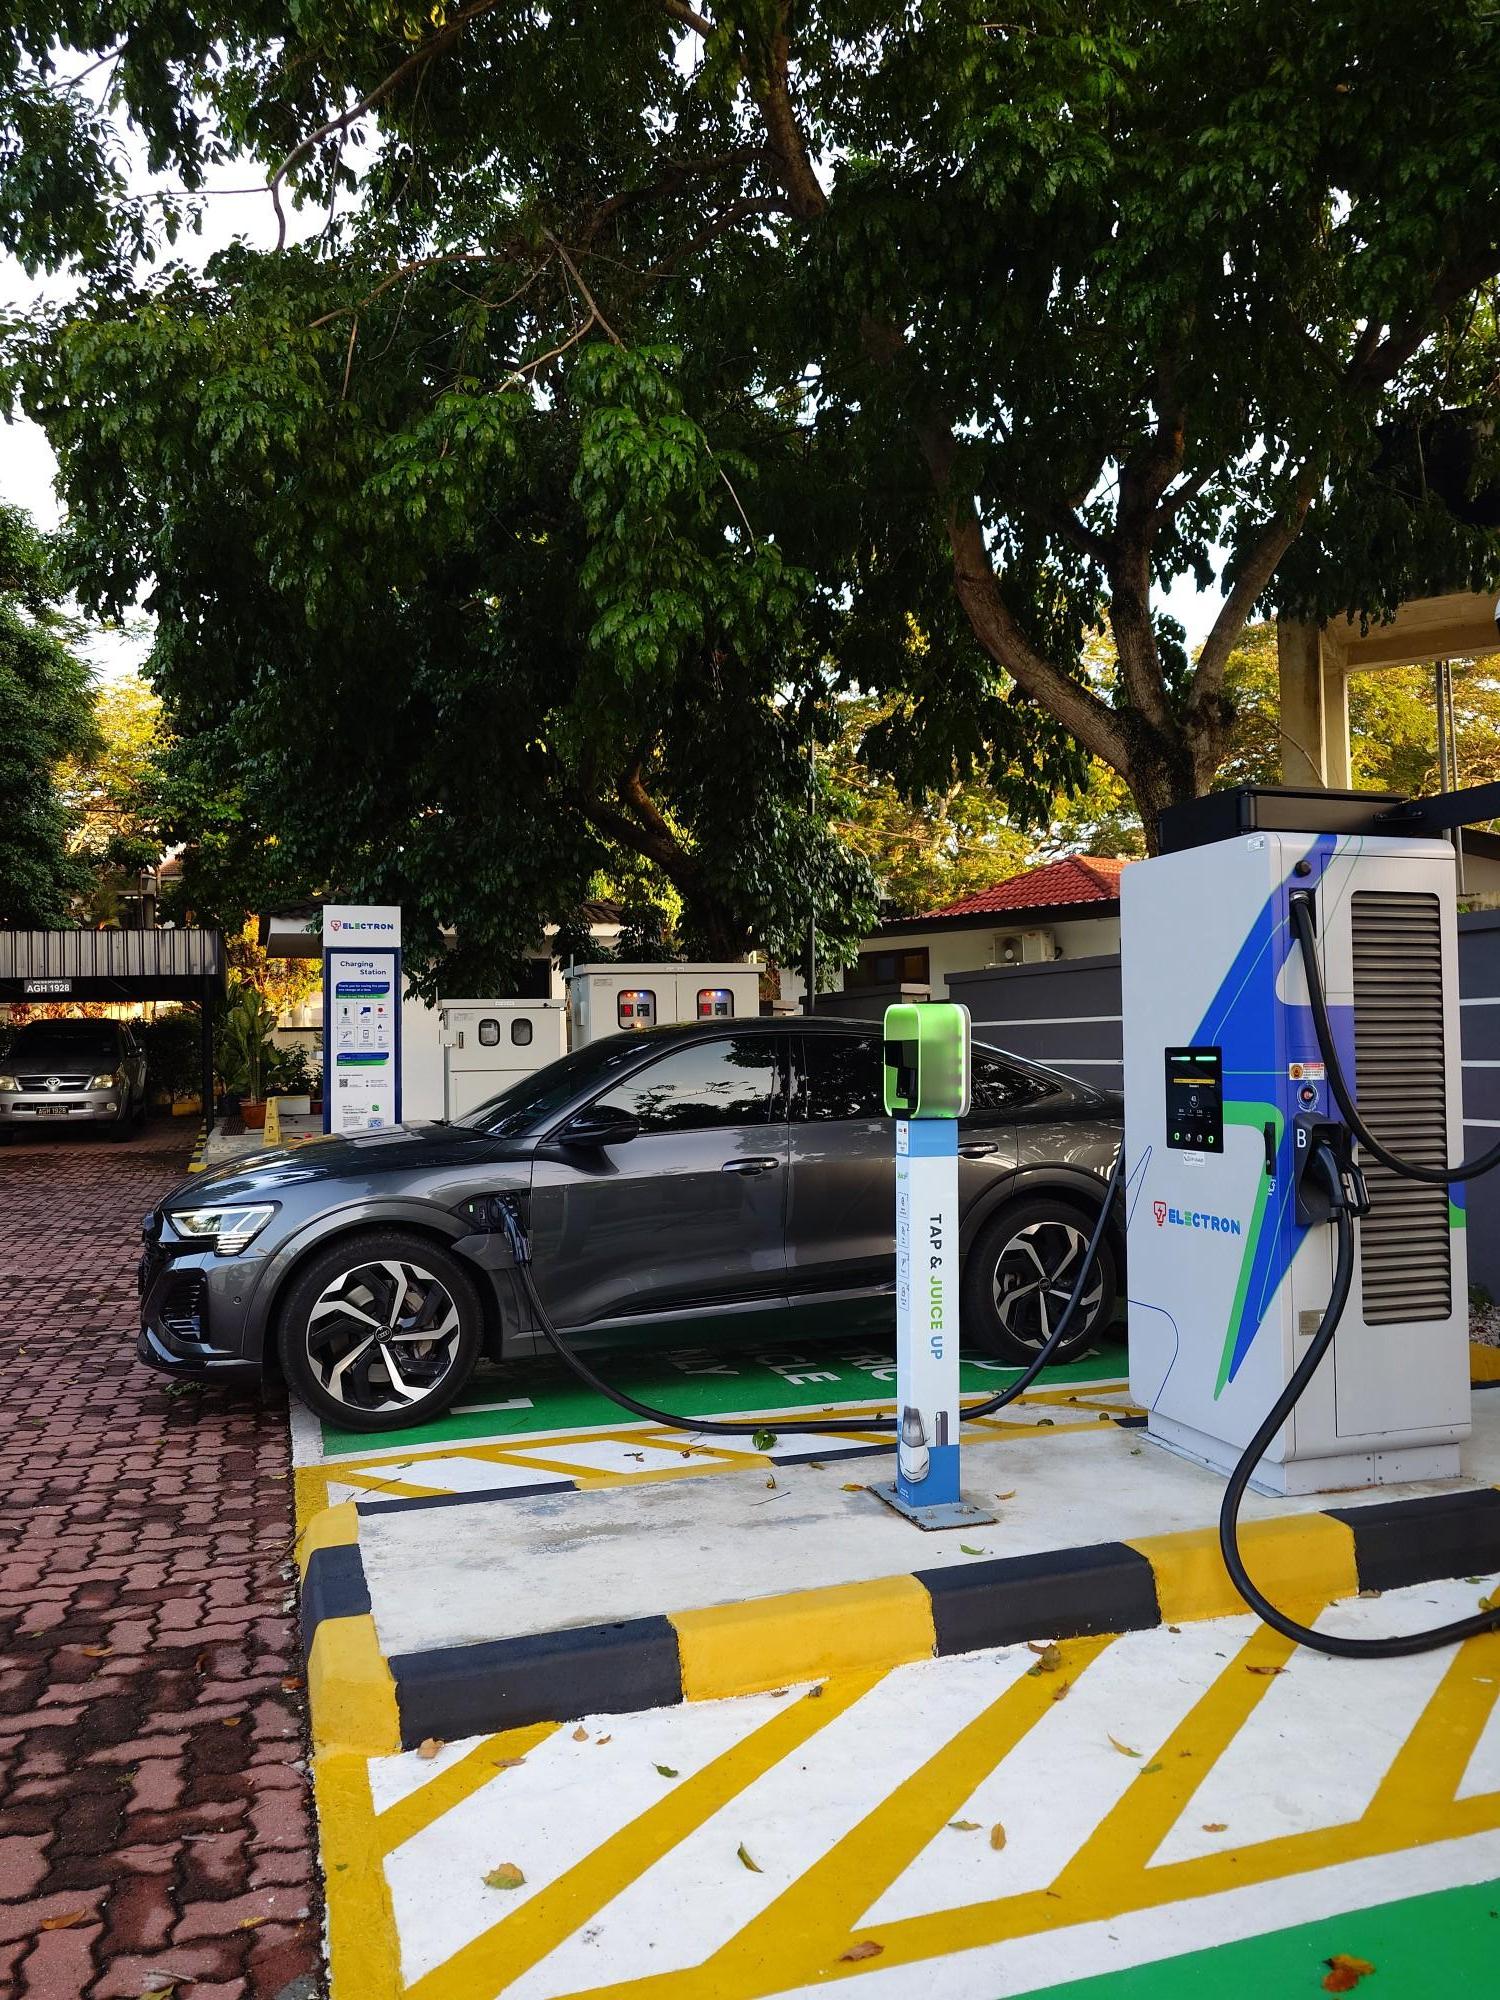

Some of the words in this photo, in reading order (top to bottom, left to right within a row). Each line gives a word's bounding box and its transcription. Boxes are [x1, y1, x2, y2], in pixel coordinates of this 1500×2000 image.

[342, 922, 394, 930] ELECTRON
[340, 960, 374, 968] Charging
[26, 984, 47, 993] AGH
[50, 984, 70, 992] 1928
[1296, 1128, 1307, 1148] B
[929, 1213, 942, 1250] TAP
[1168, 1208, 1241, 1236] ELECTRON
[930, 1256, 943, 1269] &
[930, 1275, 943, 1330] JUICE
[930, 1336, 943, 1360] UP
